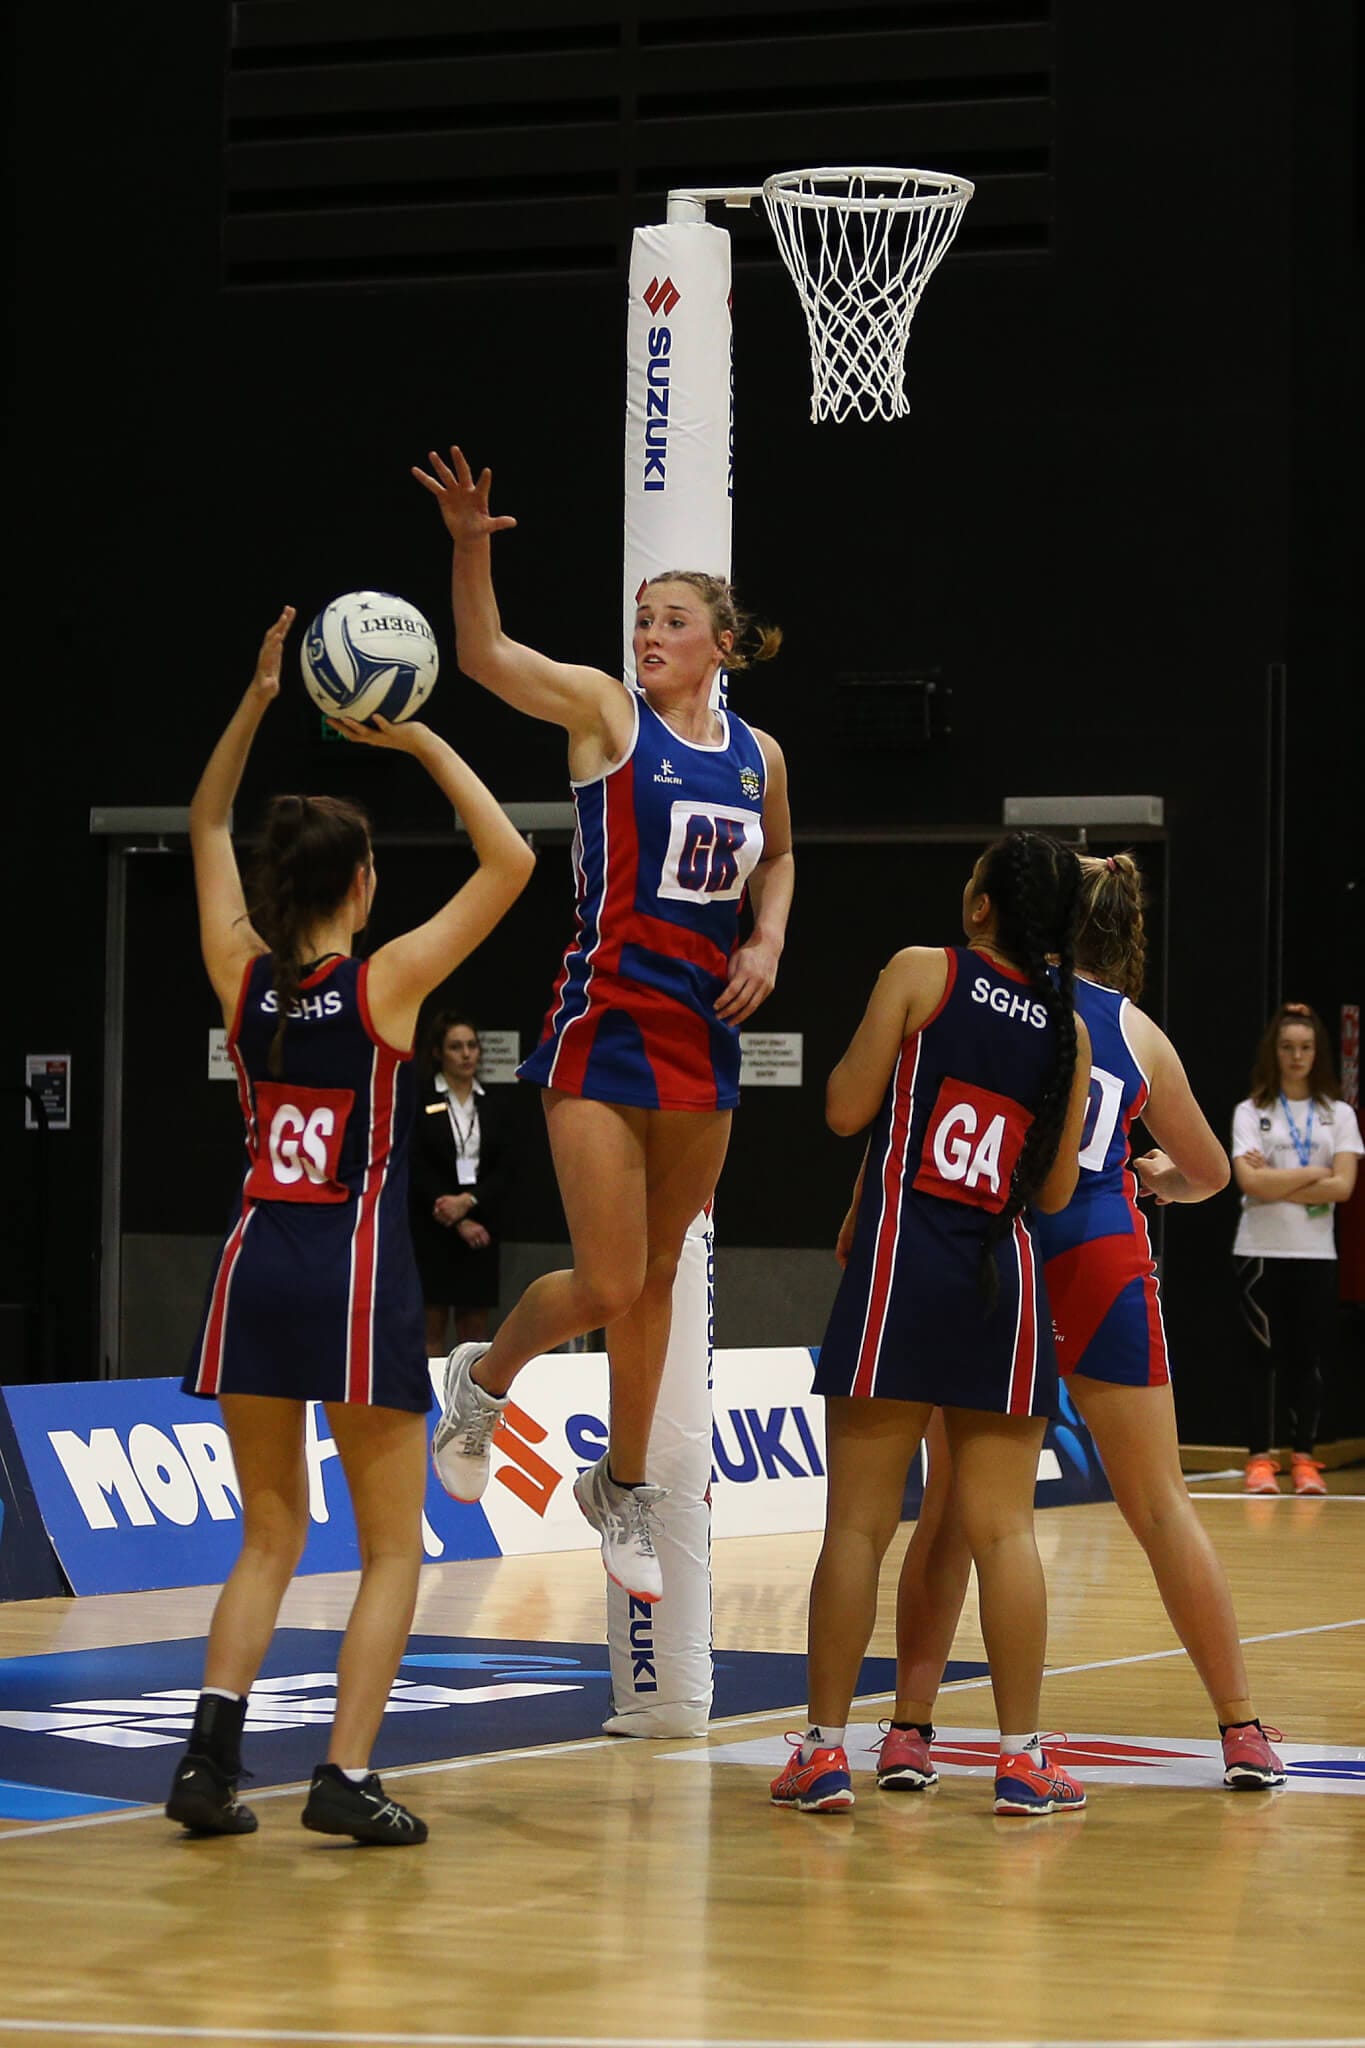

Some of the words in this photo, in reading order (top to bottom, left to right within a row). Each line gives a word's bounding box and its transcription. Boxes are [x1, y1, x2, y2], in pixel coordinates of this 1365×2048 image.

[644, 326, 671, 491] SUZUKI
[653, 773, 682, 785] KUKRI
[677, 814, 748, 892] GK
[971, 977, 1048, 1030] SGHS
[269, 1104, 334, 1184] GS
[933, 1103, 1006, 1194] GA
[47, 1422, 243, 1530] MOR
[564, 1406, 825, 1483] SUKI
[629, 1594, 658, 1693] ZUKI
